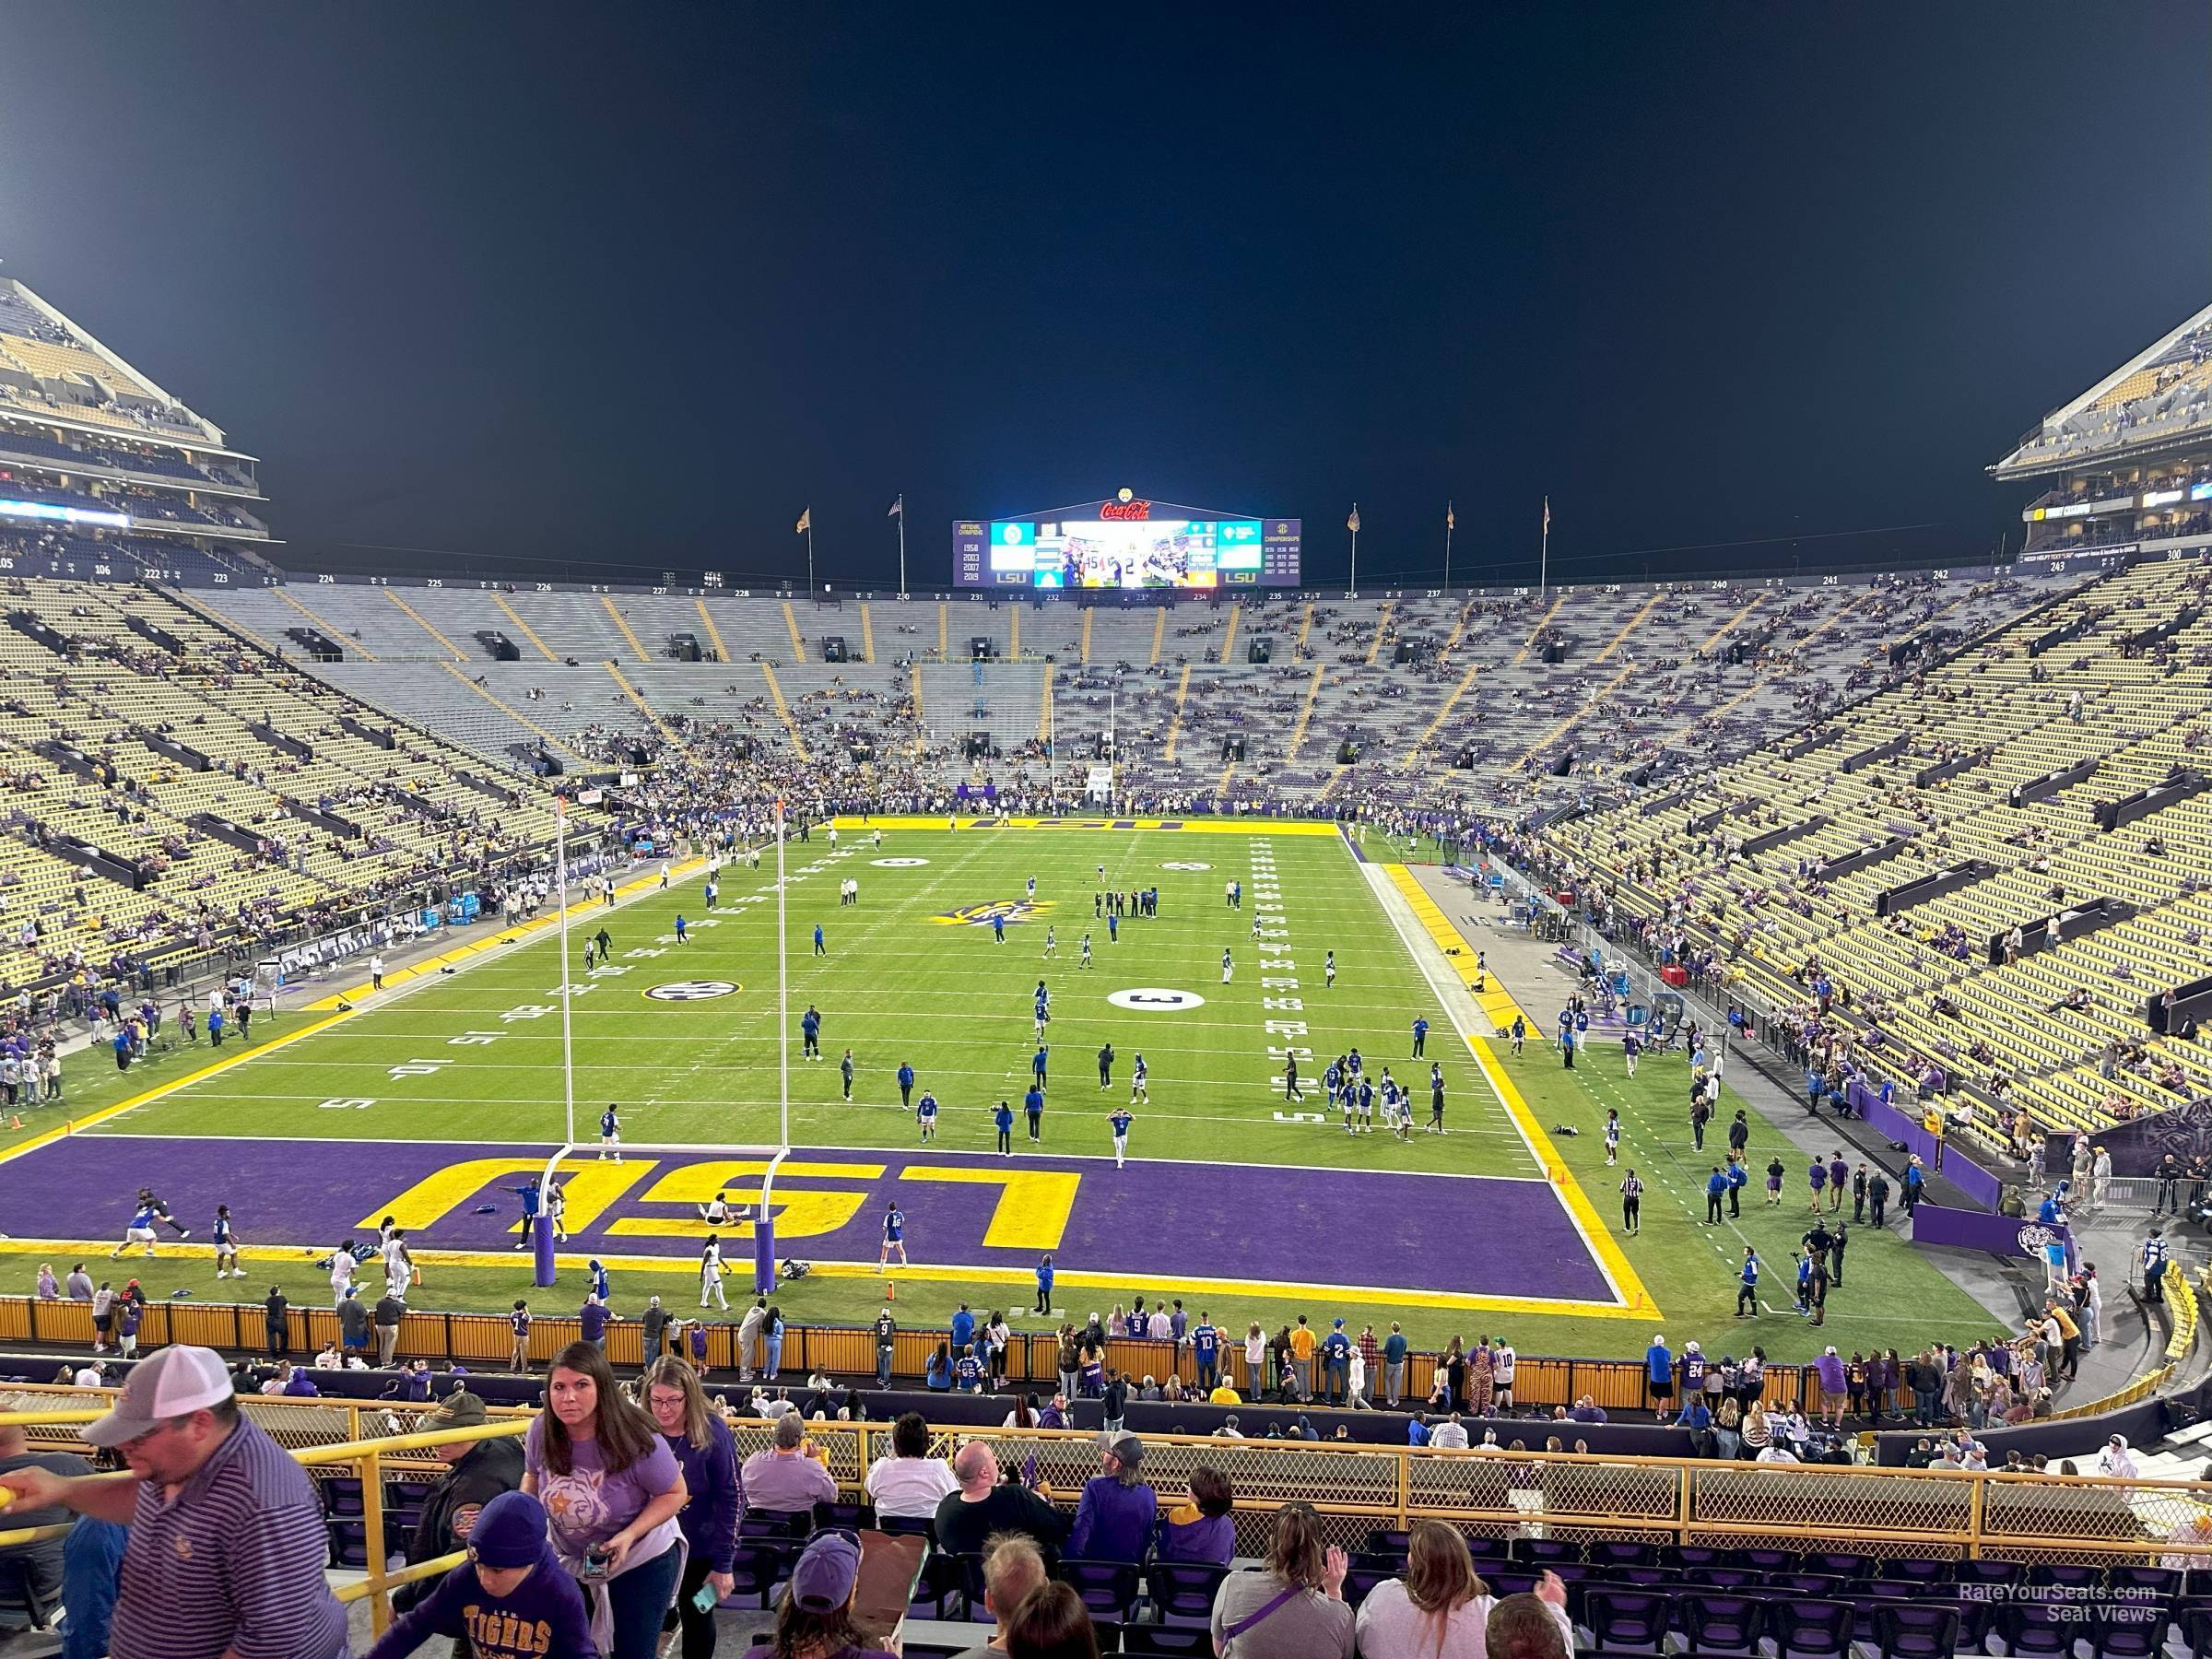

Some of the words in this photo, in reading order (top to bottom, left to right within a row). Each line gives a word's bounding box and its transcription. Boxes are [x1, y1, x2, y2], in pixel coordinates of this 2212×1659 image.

[963, 554, 980, 562] 2003
[2167, 548, 2182, 560] 300
[95, 564, 112, 575] 106
[963, 563, 980, 571] 2007
[2050, 561, 2065, 572] 243
[145, 569, 161, 579] 222
[214, 573, 229, 582] 223
[319, 574, 335, 583] 224
[996, 573, 1027, 583] LSU
[1225, 572, 1256, 582] LSU
[1933, 570, 1948, 580] 242
[427, 579, 442, 587] 225
[1712, 581, 1727, 590] 240
[1822, 576, 1838, 585] 241
[536, 582, 552, 591] 226
[653, 586, 667, 594] 227
[1606, 584, 1620, 593] 239
[971, 819, 1184, 830] LSU
[1129, 994, 1182, 1004] 3
[499, 1005, 558, 1018] 20
[1265, 1019, 1309, 1035] 20
[445, 1030, 508, 1045] 15
[387, 1058, 455, 1075] 10
[1328, 1072, 1336, 1081] 13
[317, 1099, 378, 1110] 5
[1273, 1111, 1325, 1123] 5
[1630, 1182, 1637, 1191] F
[354, 1159, 1082, 1251] LSU
[892, 1218, 901, 1228] 46
[513, 1318, 520, 1330] 7
[881, 1324, 888, 1335] 9
[1134, 1320, 1141, 1333] 9
[1200, 1336, 1213, 1350] 10
[1335, 1344, 1344, 1359] 2
[1503, 1353, 1513, 1368] 10
[1688, 1365, 1703, 1378] 24
[463, 1605, 552, 1653] TIGERS
